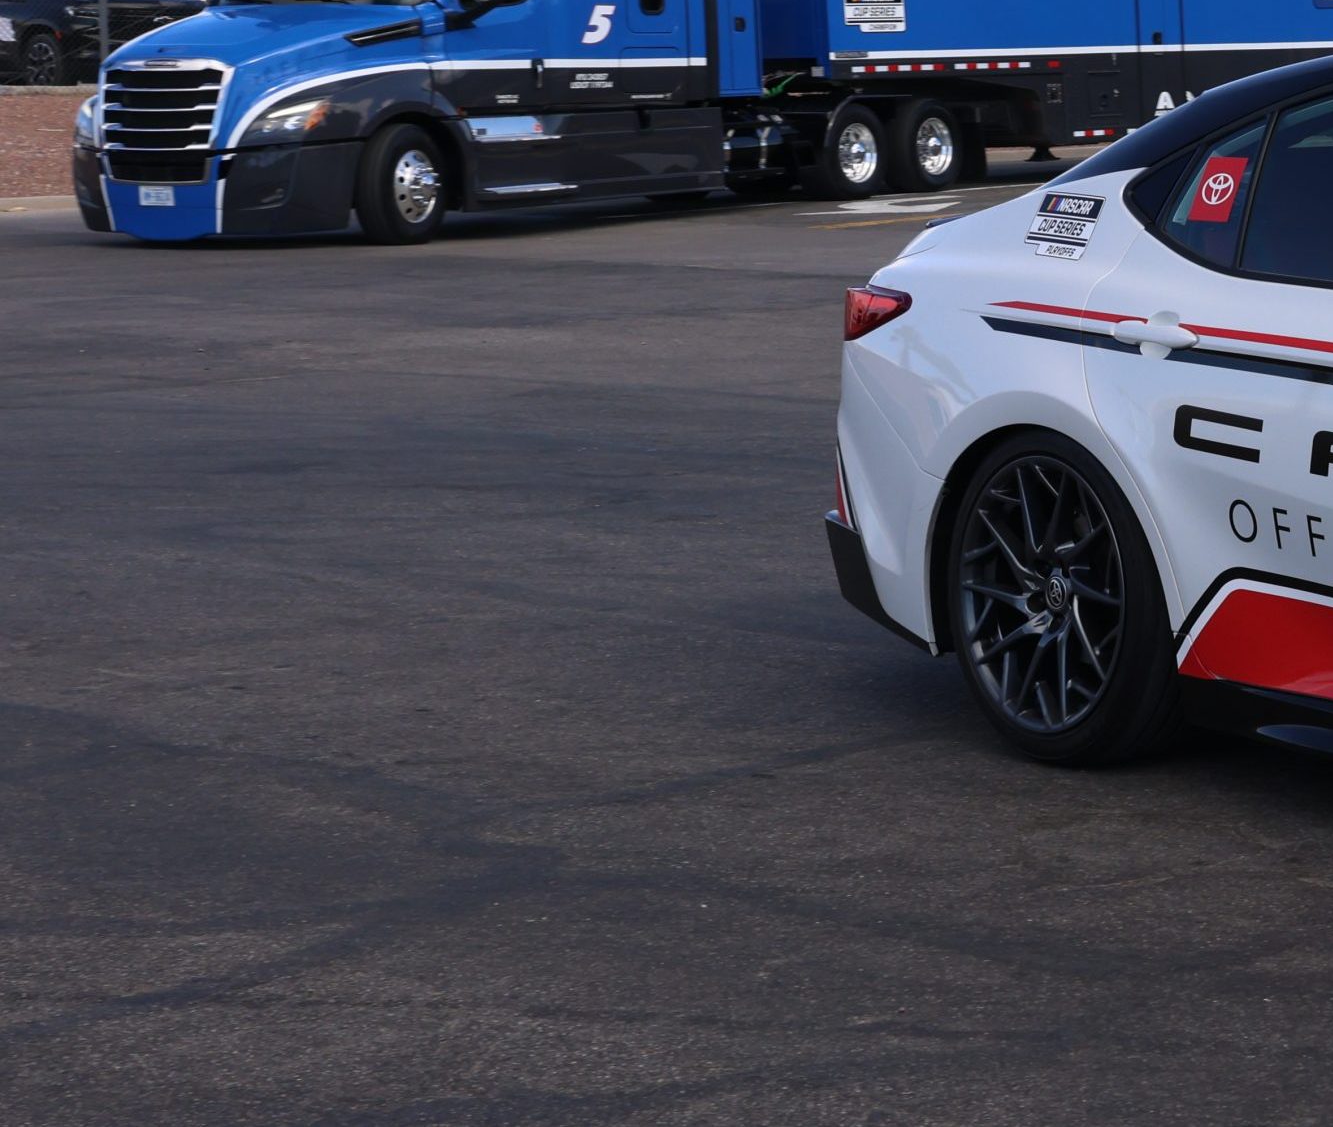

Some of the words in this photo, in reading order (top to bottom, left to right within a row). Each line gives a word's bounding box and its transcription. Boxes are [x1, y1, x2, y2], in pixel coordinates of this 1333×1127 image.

[869, 6, 896, 17] SERIES
[582, 4, 616, 44] 5
[1059, 197, 1095, 215] NASCAR
[1038, 219, 1056, 233] CUP
[1057, 221, 1086, 236] SERIES
[1046, 245, 1077, 258] PLAYOFFS
